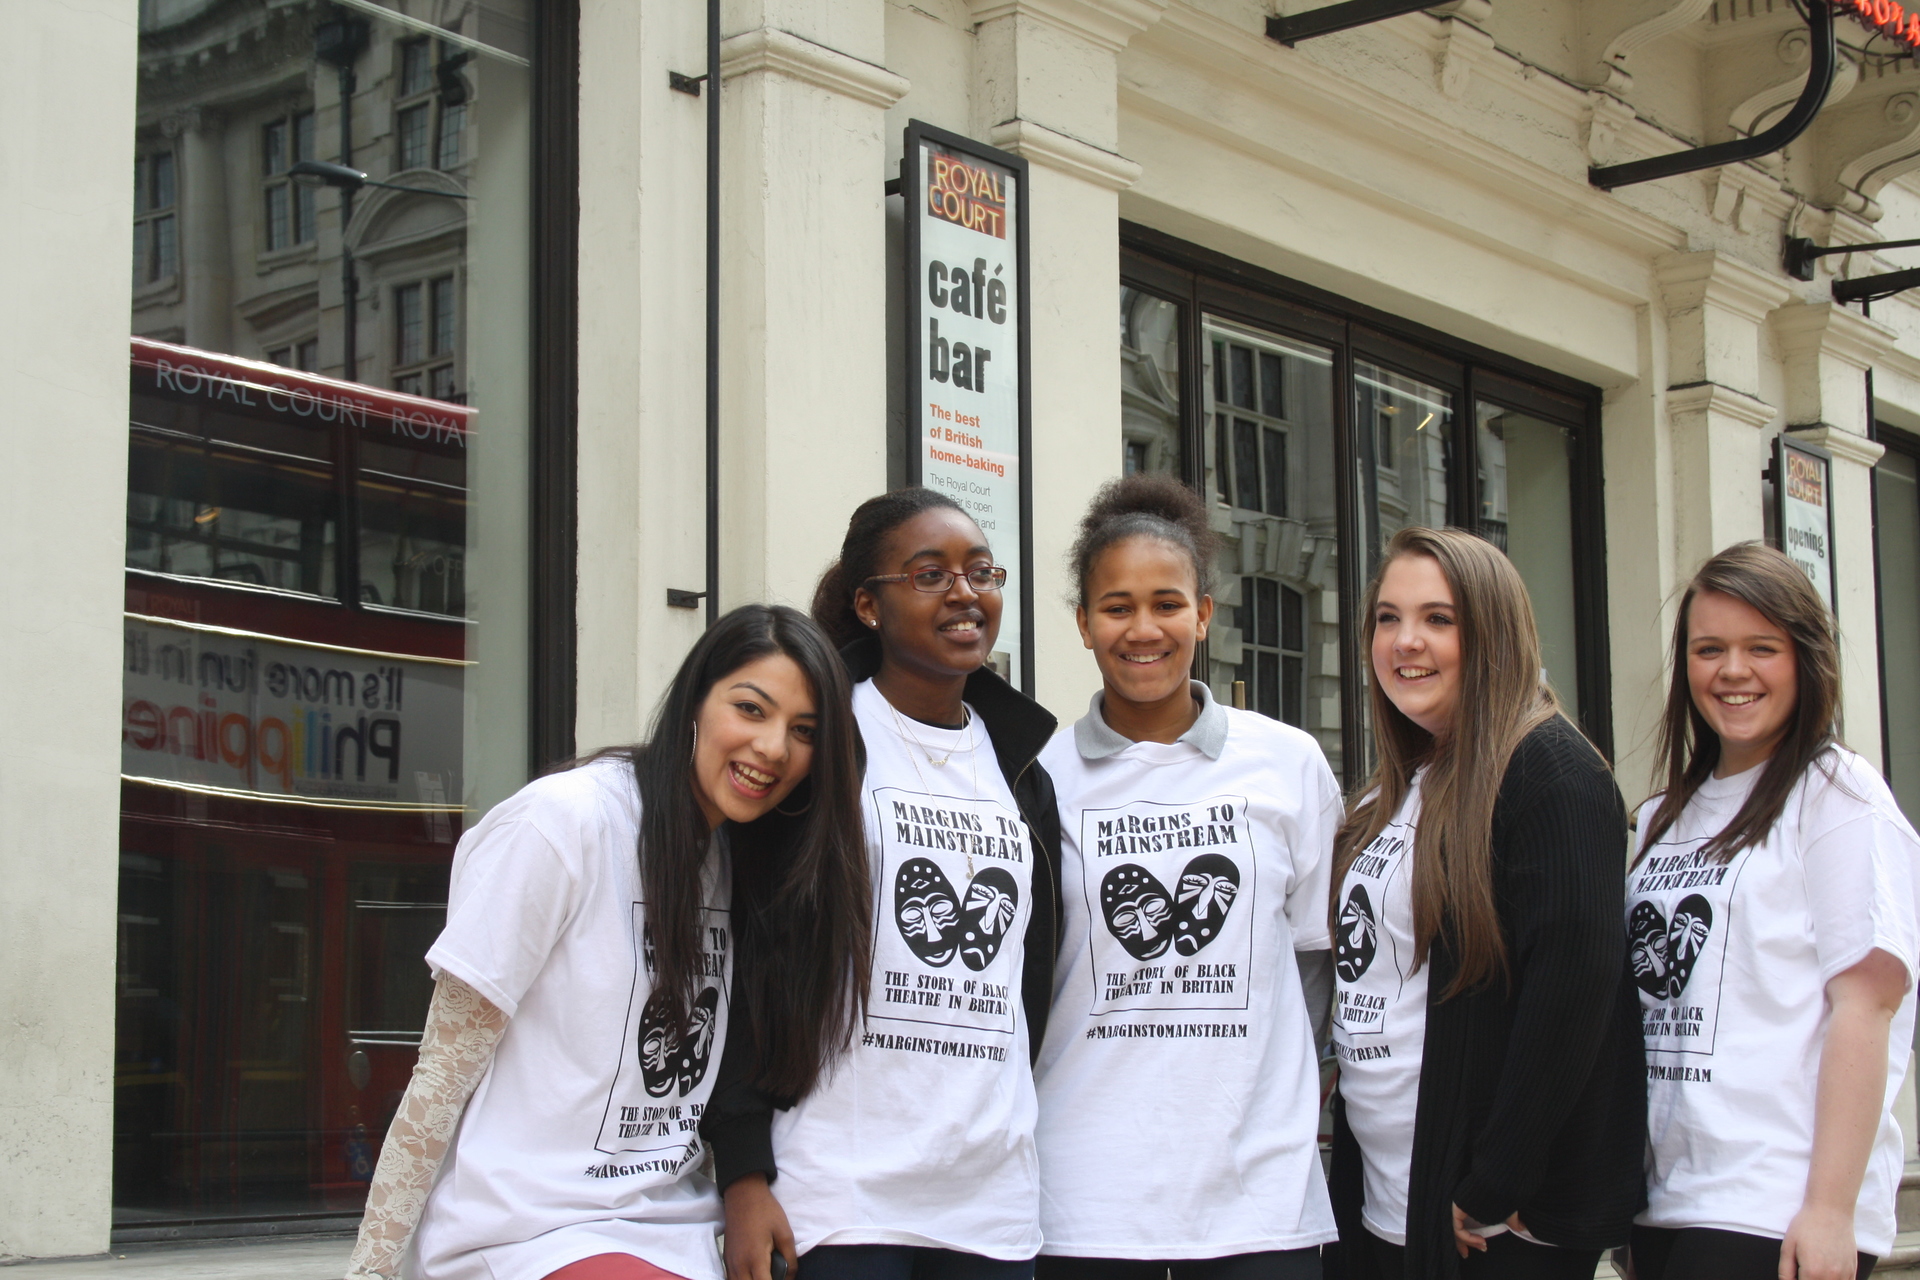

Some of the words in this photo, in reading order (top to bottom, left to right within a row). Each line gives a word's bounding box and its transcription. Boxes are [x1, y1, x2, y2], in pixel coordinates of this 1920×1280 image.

[935, 159, 1005, 203] ROYAL
[929, 185, 1001, 237] COURT
[928, 257, 1007, 325] café
[930, 317, 991, 393] bar
[156, 358, 256, 407] ROYAL
[266, 383, 373, 428] COURT
[392, 406, 464, 448] ROYA
[930, 403, 952, 421] The
[955, 408, 980, 429] best
[930, 427, 942, 439] of
[945, 428, 983, 450] British
[930, 445, 1005, 477] home-baking
[1789, 457, 1821, 482] ROYAL
[930, 473, 945, 487] The
[946, 476, 968, 493] Royal
[969, 481, 991, 497] Court
[1787, 475, 1820, 505] COURT
[965, 498, 972, 509] is
[973, 501, 993, 513] open
[981, 519, 996, 530] and
[1788, 526, 1825, 559] opening
[892, 801, 982, 832] MARGINS
[996, 816, 1019, 838] TO
[1098, 812, 1191, 838] MARGINS
[1207, 803, 1234, 822] TO
[896, 822, 1023, 863] MAINSTREAM
[1097, 825, 1237, 857] MAINSTREAM
[1633, 867, 1729, 895] MAINSTREAM
[709, 927, 727, 951] TO
[885, 971, 909, 987] THE
[917, 974, 955, 991] STORY
[963, 979, 977, 995] OF
[1106, 973, 1127, 986] THE
[1133, 965, 1166, 981] STORY
[1174, 965, 1189, 979] OF
[1197, 964, 1236, 978] BLACK
[885, 988, 942, 1007] THEATRE
[948, 994, 962, 1009] IN
[1105, 981, 1153, 1000] THEATRE
[1160, 981, 1174, 994] IN
[1182, 980, 1234, 993] BRITAIN
[1353, 993, 1387, 1010] BLACK
[1086, 1024, 1248, 1040] #MARGINSTOMAINSTREAM
[1660, 1023, 1671, 1036] IN
[620, 1105, 639, 1121] THE
[669, 1105, 682, 1120] OF
[657, 1122, 671, 1136] IN
